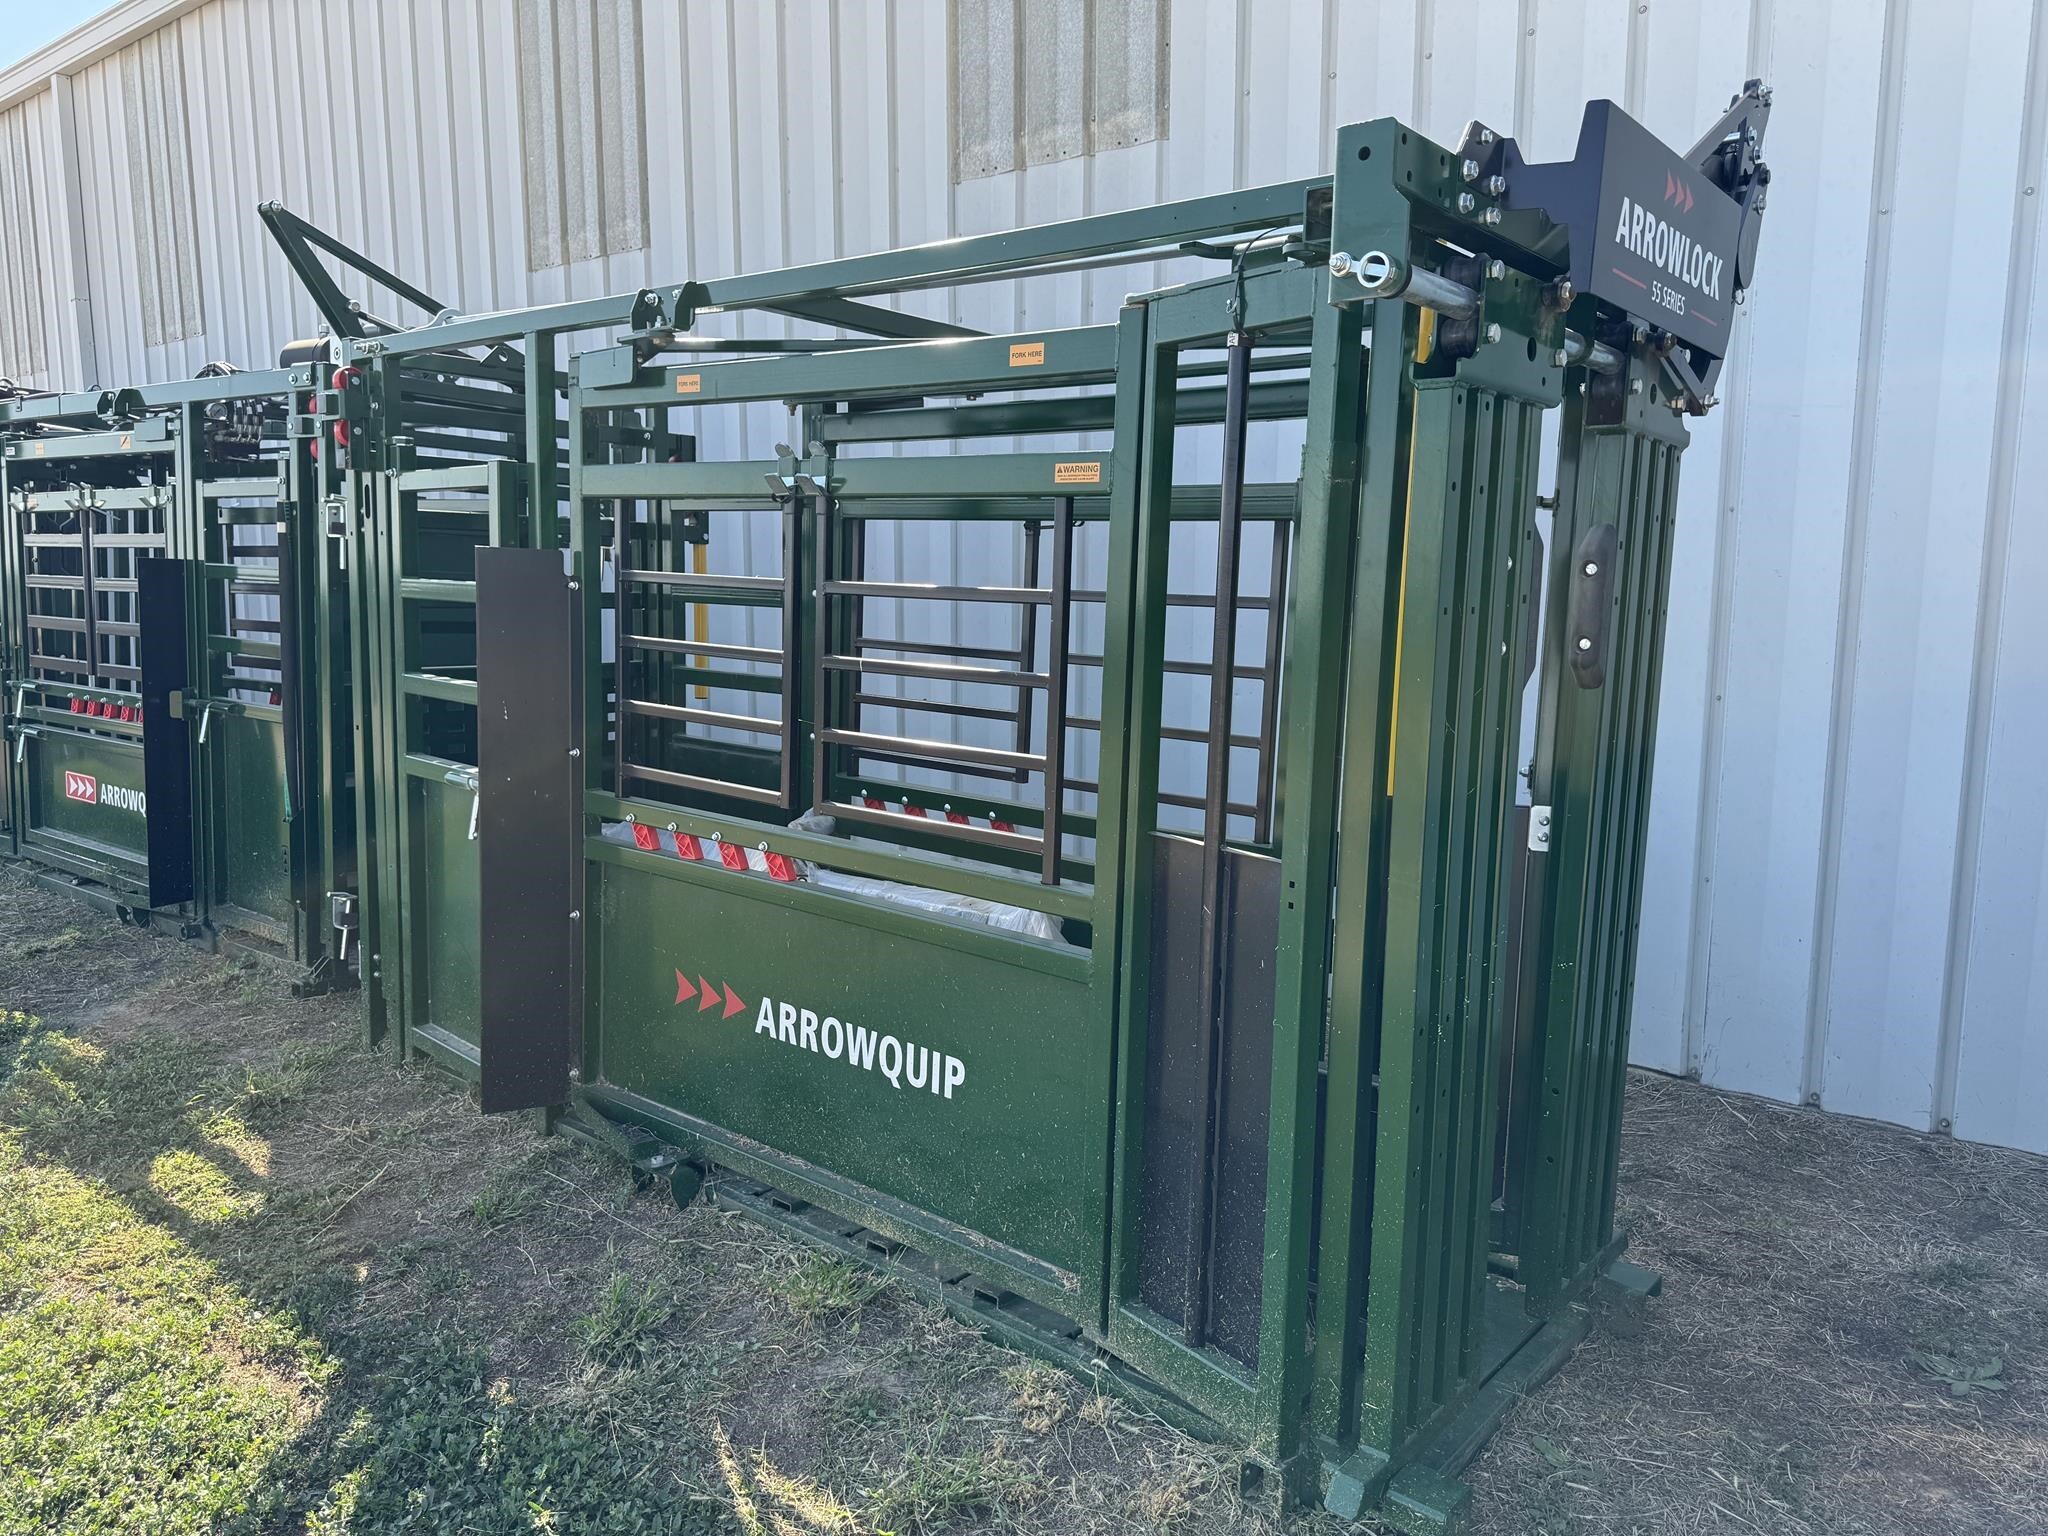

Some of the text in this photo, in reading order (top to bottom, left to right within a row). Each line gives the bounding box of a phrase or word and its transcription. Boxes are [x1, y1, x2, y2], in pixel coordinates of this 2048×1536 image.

[1615, 196, 1723, 301] ARROWLOCK
[1651, 280, 1686, 316] 55 SERIES
[1027, 350, 1043, 358] HERE
[1063, 464, 1099, 473] WARNING
[754, 996, 966, 1100] ARROWQUIP
